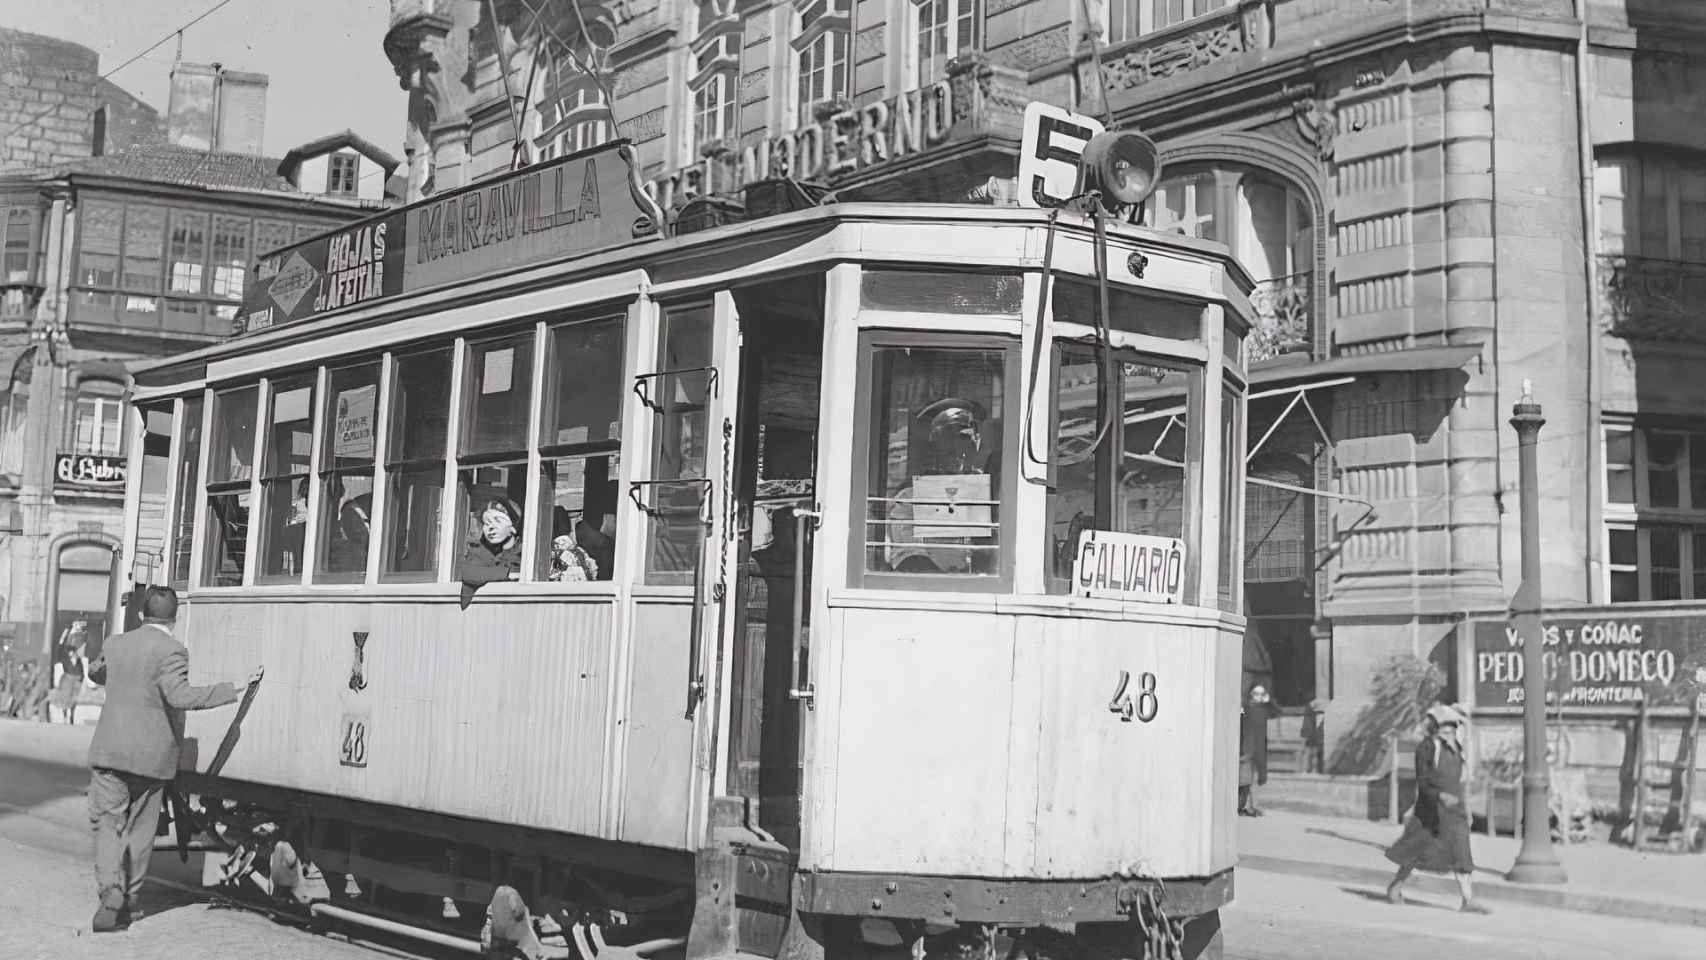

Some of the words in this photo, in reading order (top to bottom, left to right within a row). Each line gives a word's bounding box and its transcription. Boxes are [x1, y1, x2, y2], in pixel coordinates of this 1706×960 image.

[1032, 114, 1094, 208] 5
[416, 157, 601, 264] MARAVILLA
[327, 222, 387, 275] HOJAS
[1079, 540, 1181, 595] CALVARIO
[1581, 621, 1643, 645] COÑAC
[1478, 650, 1557, 682] PEDO
[1569, 649, 1675, 687] DOMECQ
[1109, 669, 1159, 723] 48
[341, 720, 366, 763] 48
